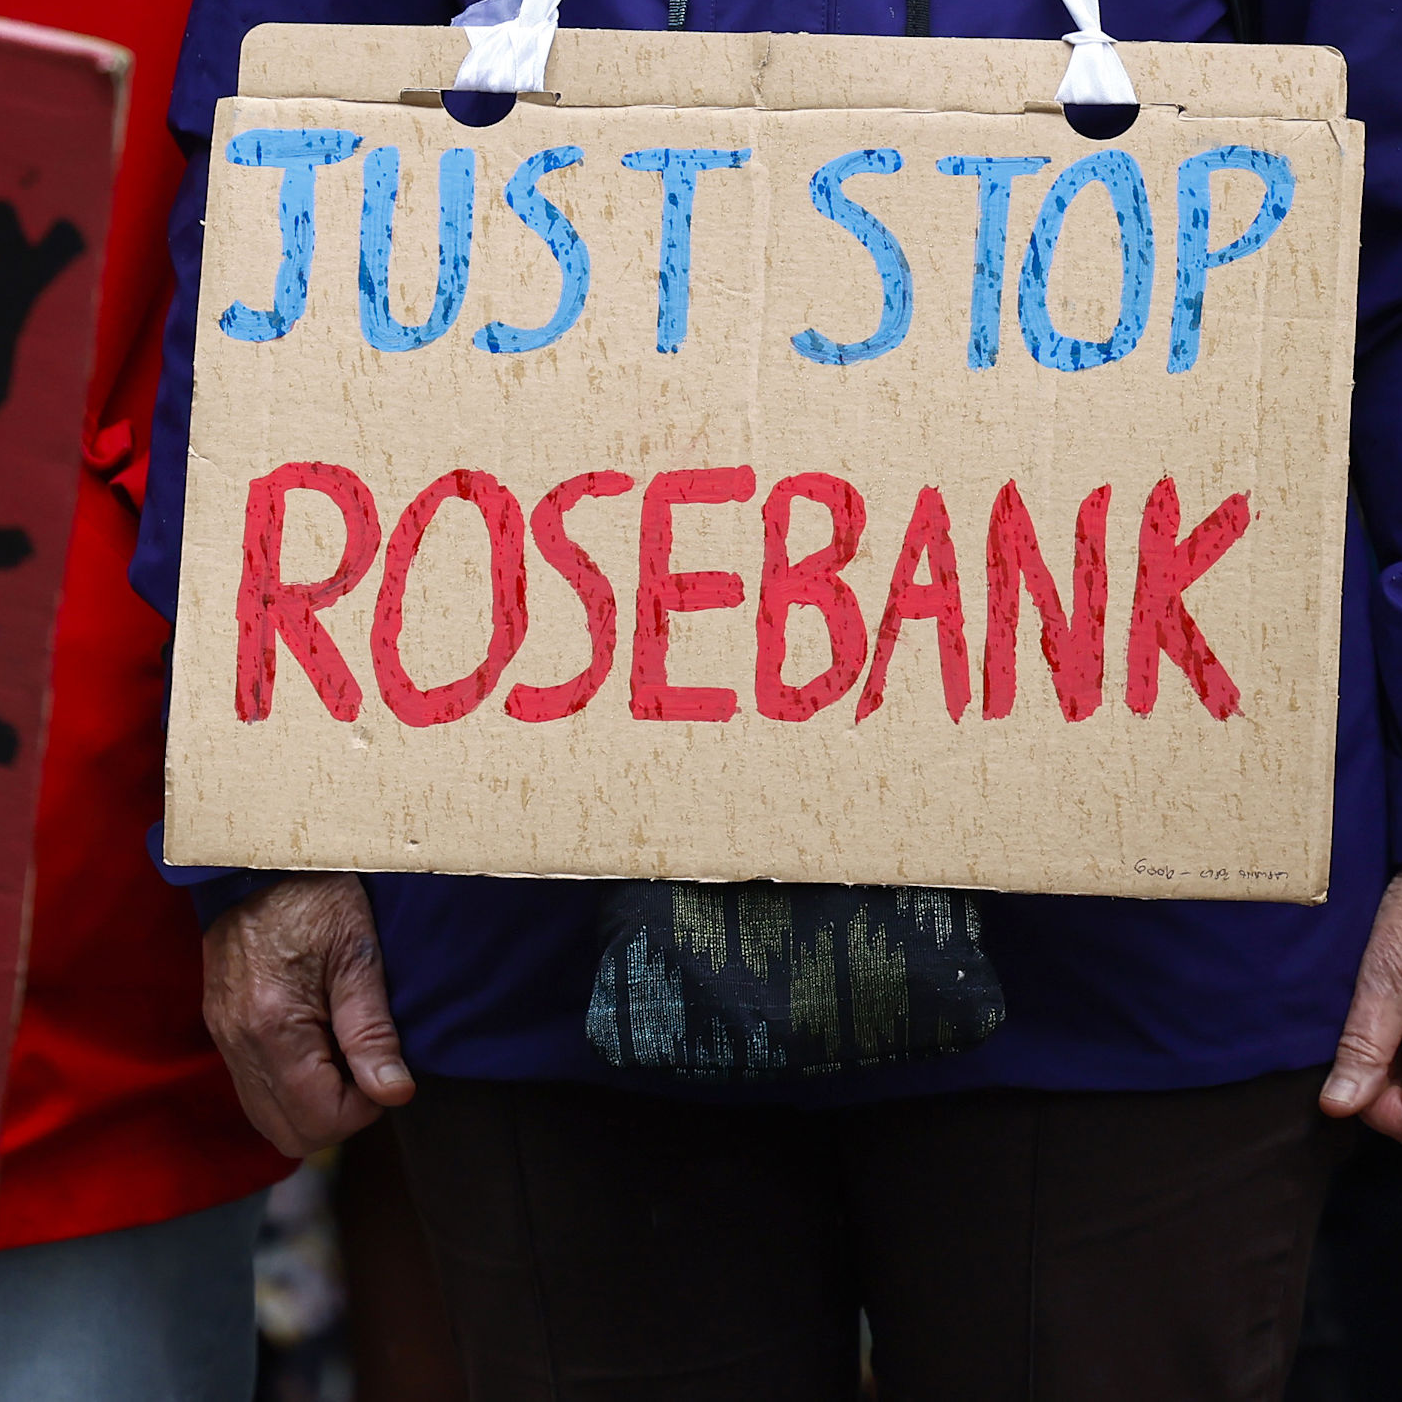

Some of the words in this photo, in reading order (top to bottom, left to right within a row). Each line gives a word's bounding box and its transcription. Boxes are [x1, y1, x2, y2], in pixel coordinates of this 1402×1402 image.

[219, 128, 752, 355] JUST
[791, 144, 1296, 375] STOP
[234, 461, 1253, 728] ROSEBANK
